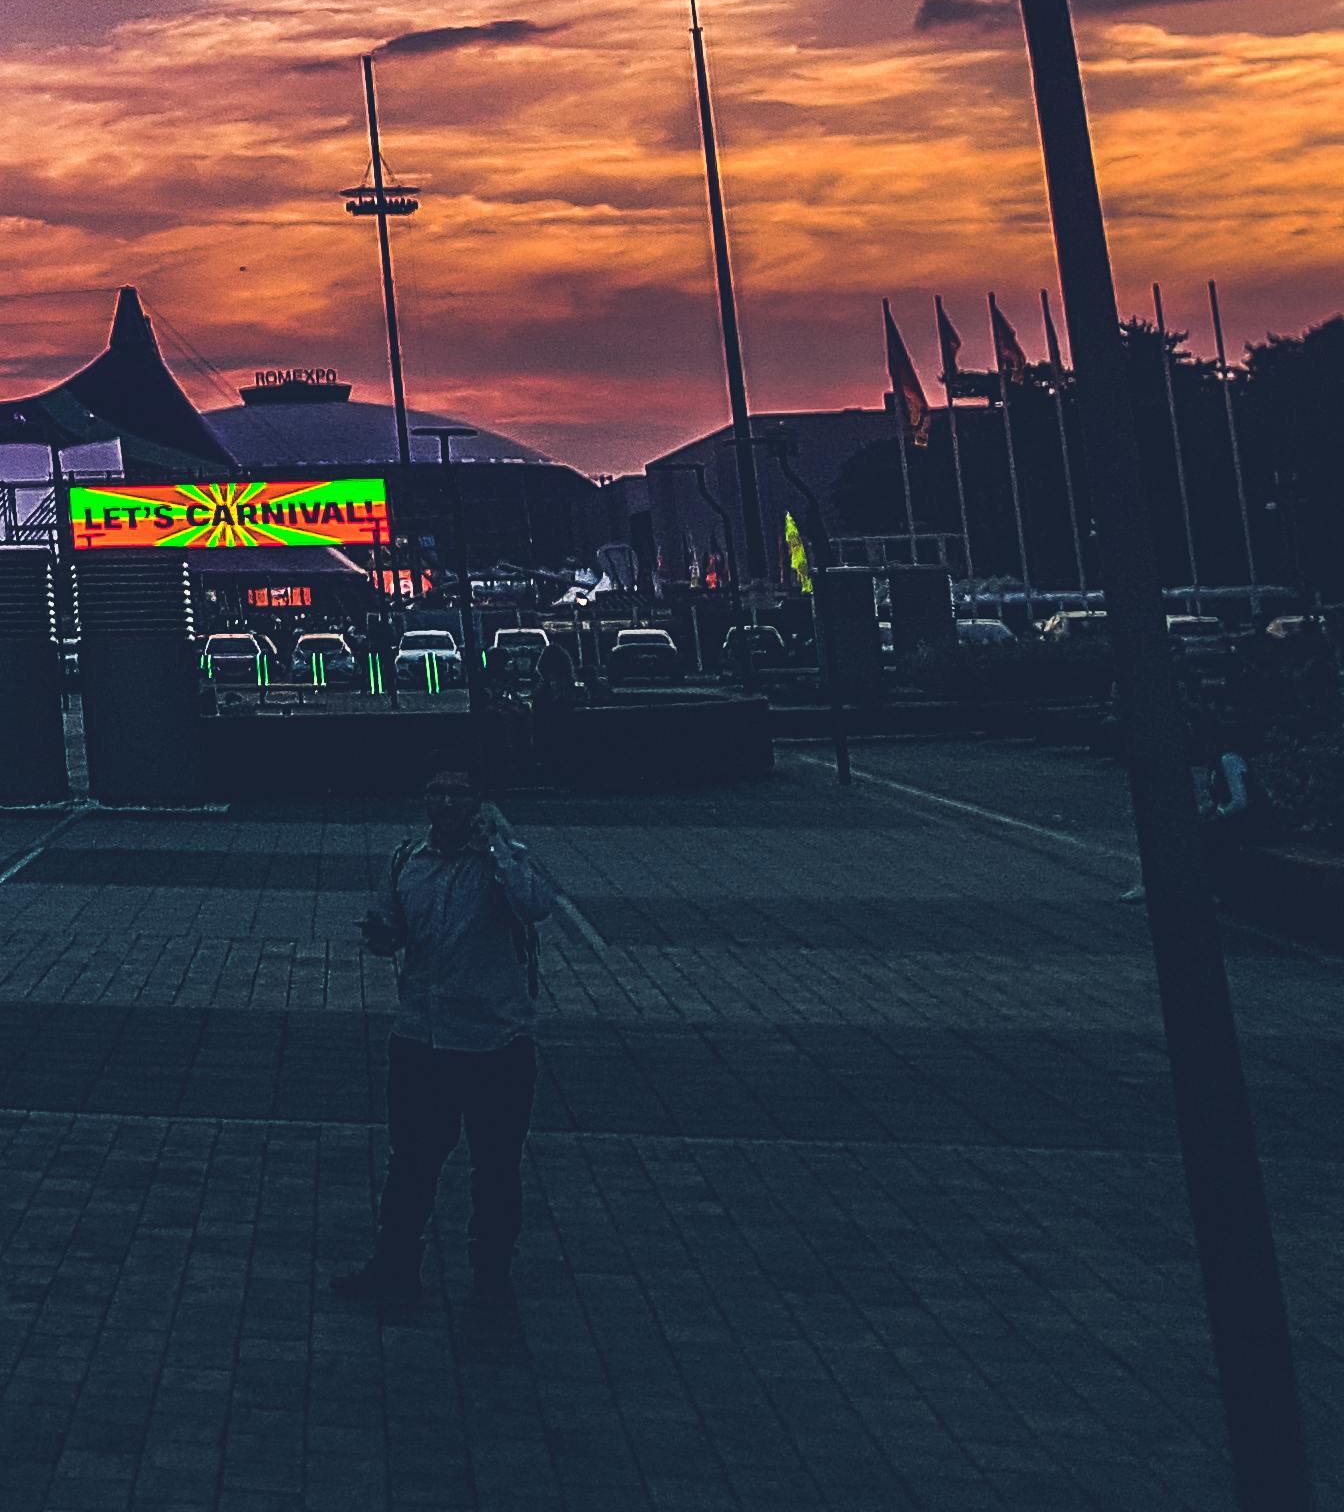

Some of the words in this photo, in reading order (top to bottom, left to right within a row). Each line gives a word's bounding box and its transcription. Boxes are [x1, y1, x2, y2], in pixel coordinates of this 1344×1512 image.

[255, 368, 337, 386] ROMEXPO
[85, 505, 174, 530] LET'S
[185, 500, 374, 527] CARNIVAL!
